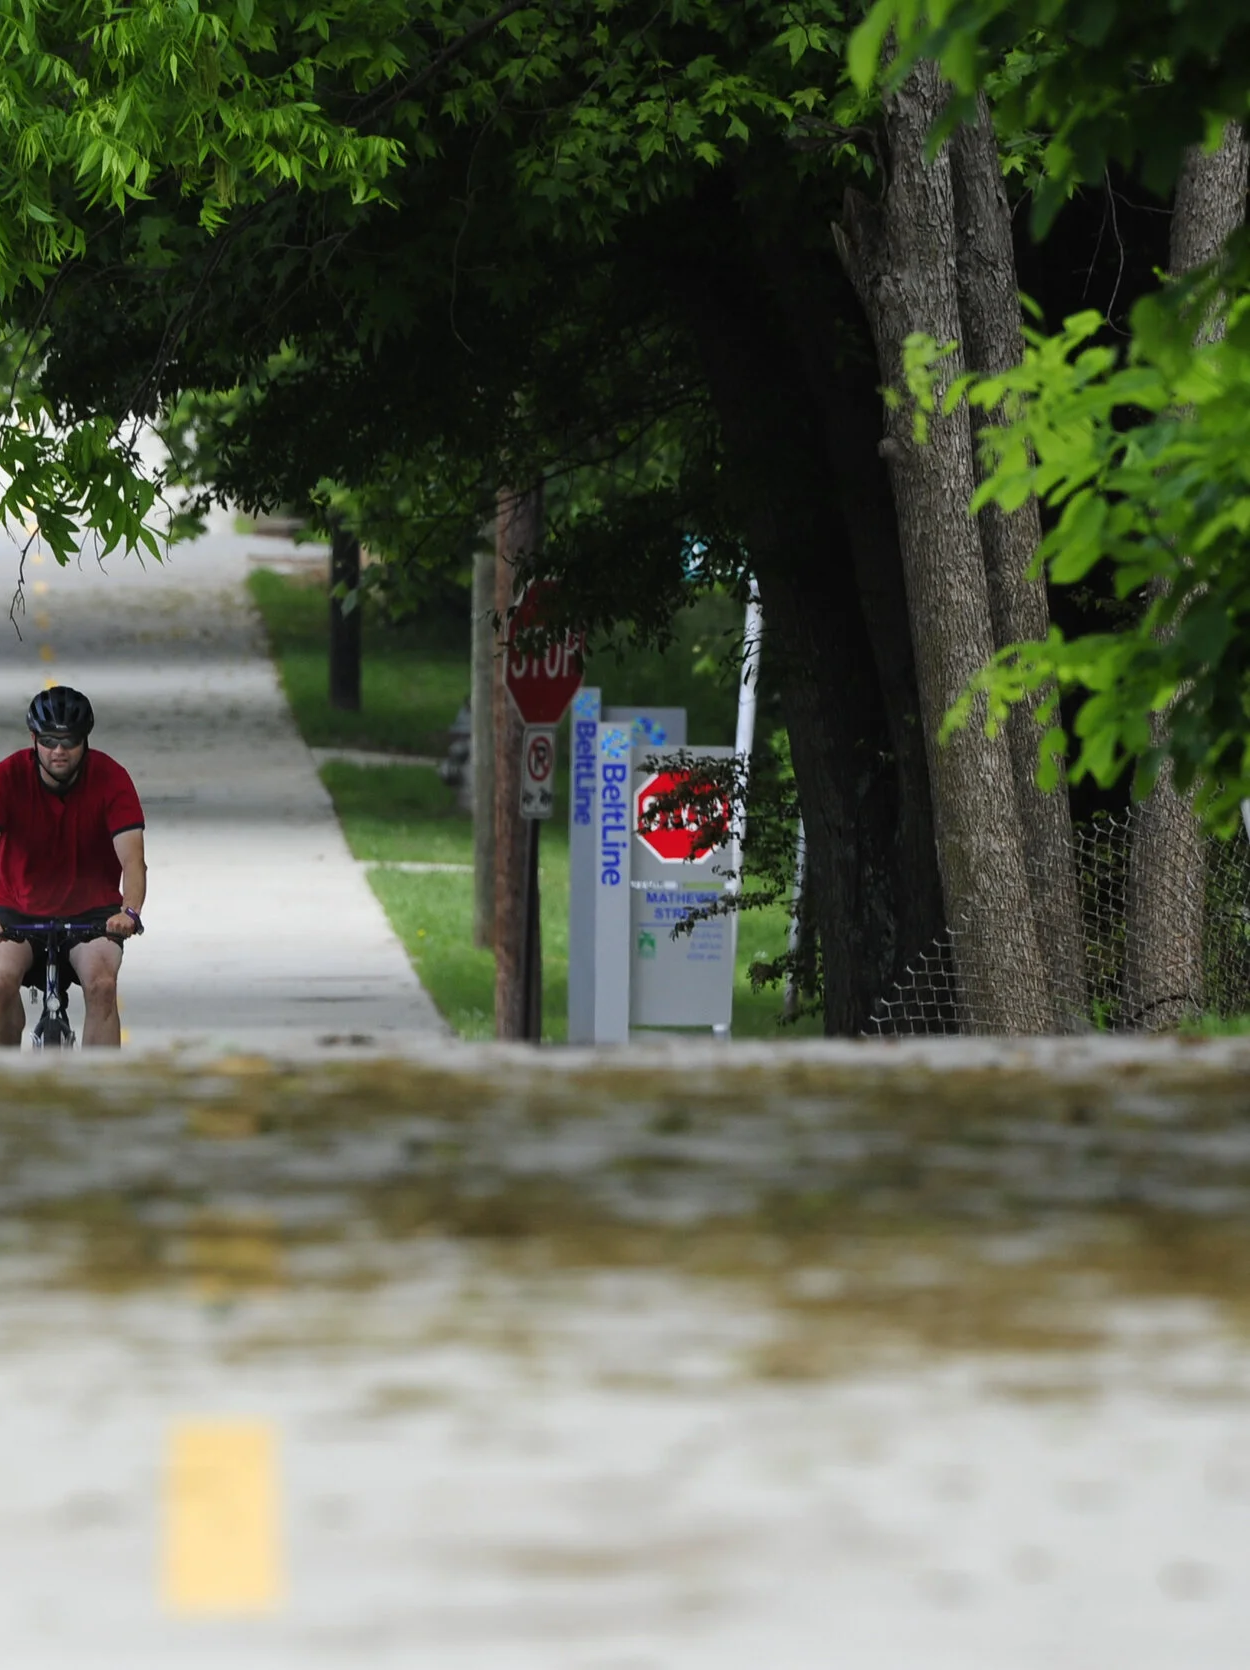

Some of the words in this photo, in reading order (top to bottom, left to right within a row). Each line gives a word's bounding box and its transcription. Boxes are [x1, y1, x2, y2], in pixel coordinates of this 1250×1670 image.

[574, 721, 597, 826] BeltLine
[601, 763, 627, 886] BeltLine
[654, 907, 709, 920] STRE
